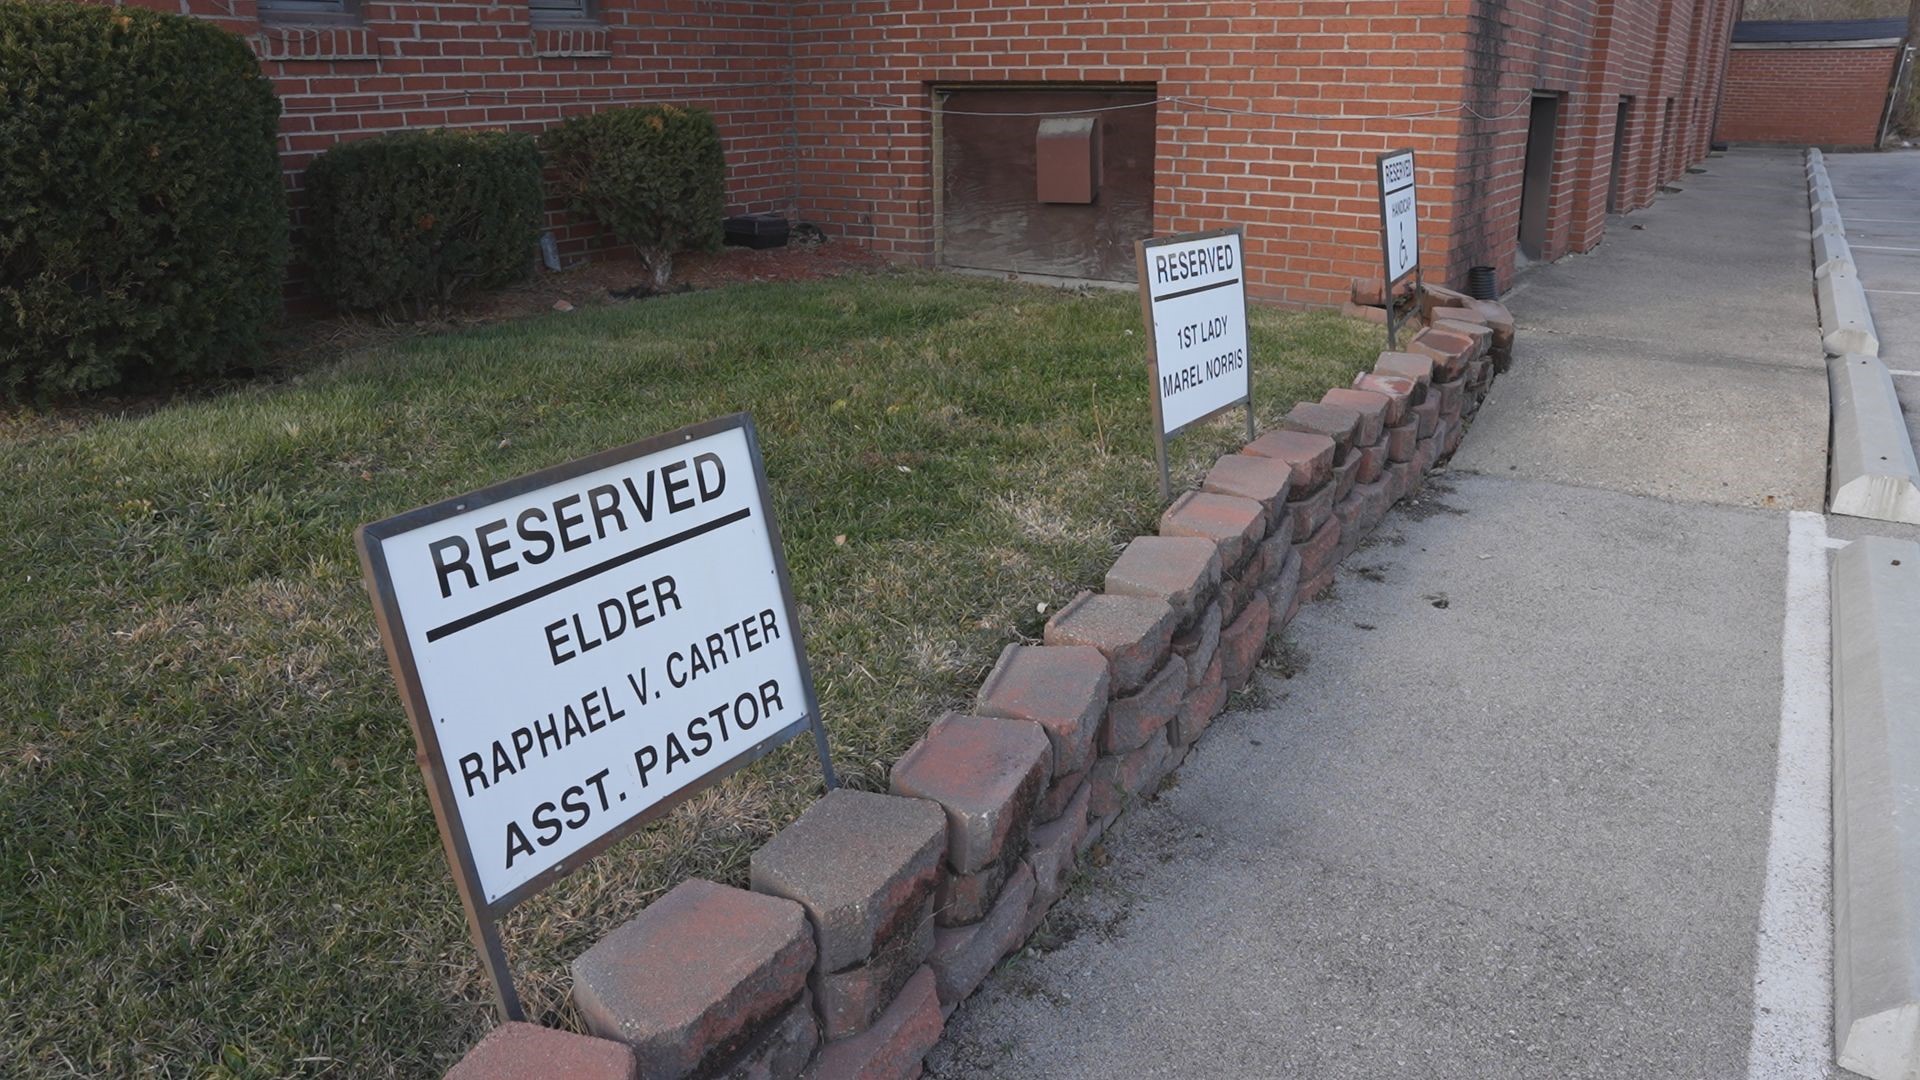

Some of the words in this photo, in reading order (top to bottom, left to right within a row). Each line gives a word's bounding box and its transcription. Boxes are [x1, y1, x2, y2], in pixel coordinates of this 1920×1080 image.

[1385, 159, 1412, 183] RESERVED
[1391, 196, 1411, 217] HANDICAP
[1156, 244, 1234, 284] RESERVED
[1177, 324, 1198, 350] 1ST
[1201, 315, 1228, 343] LADY
[1163, 366, 1203, 398] MAREL
[1206, 349, 1243, 380] NORRIS
[429, 452, 727, 599] RESERVED
[544, 575, 682, 666] ELDER
[458, 686, 626, 798] RAPHAEL
[627, 667, 662, 706] V.
[666, 608, 782, 689] CARTER
[505, 768, 628, 870] ASST.
[634, 679, 785, 789] PASTOR
